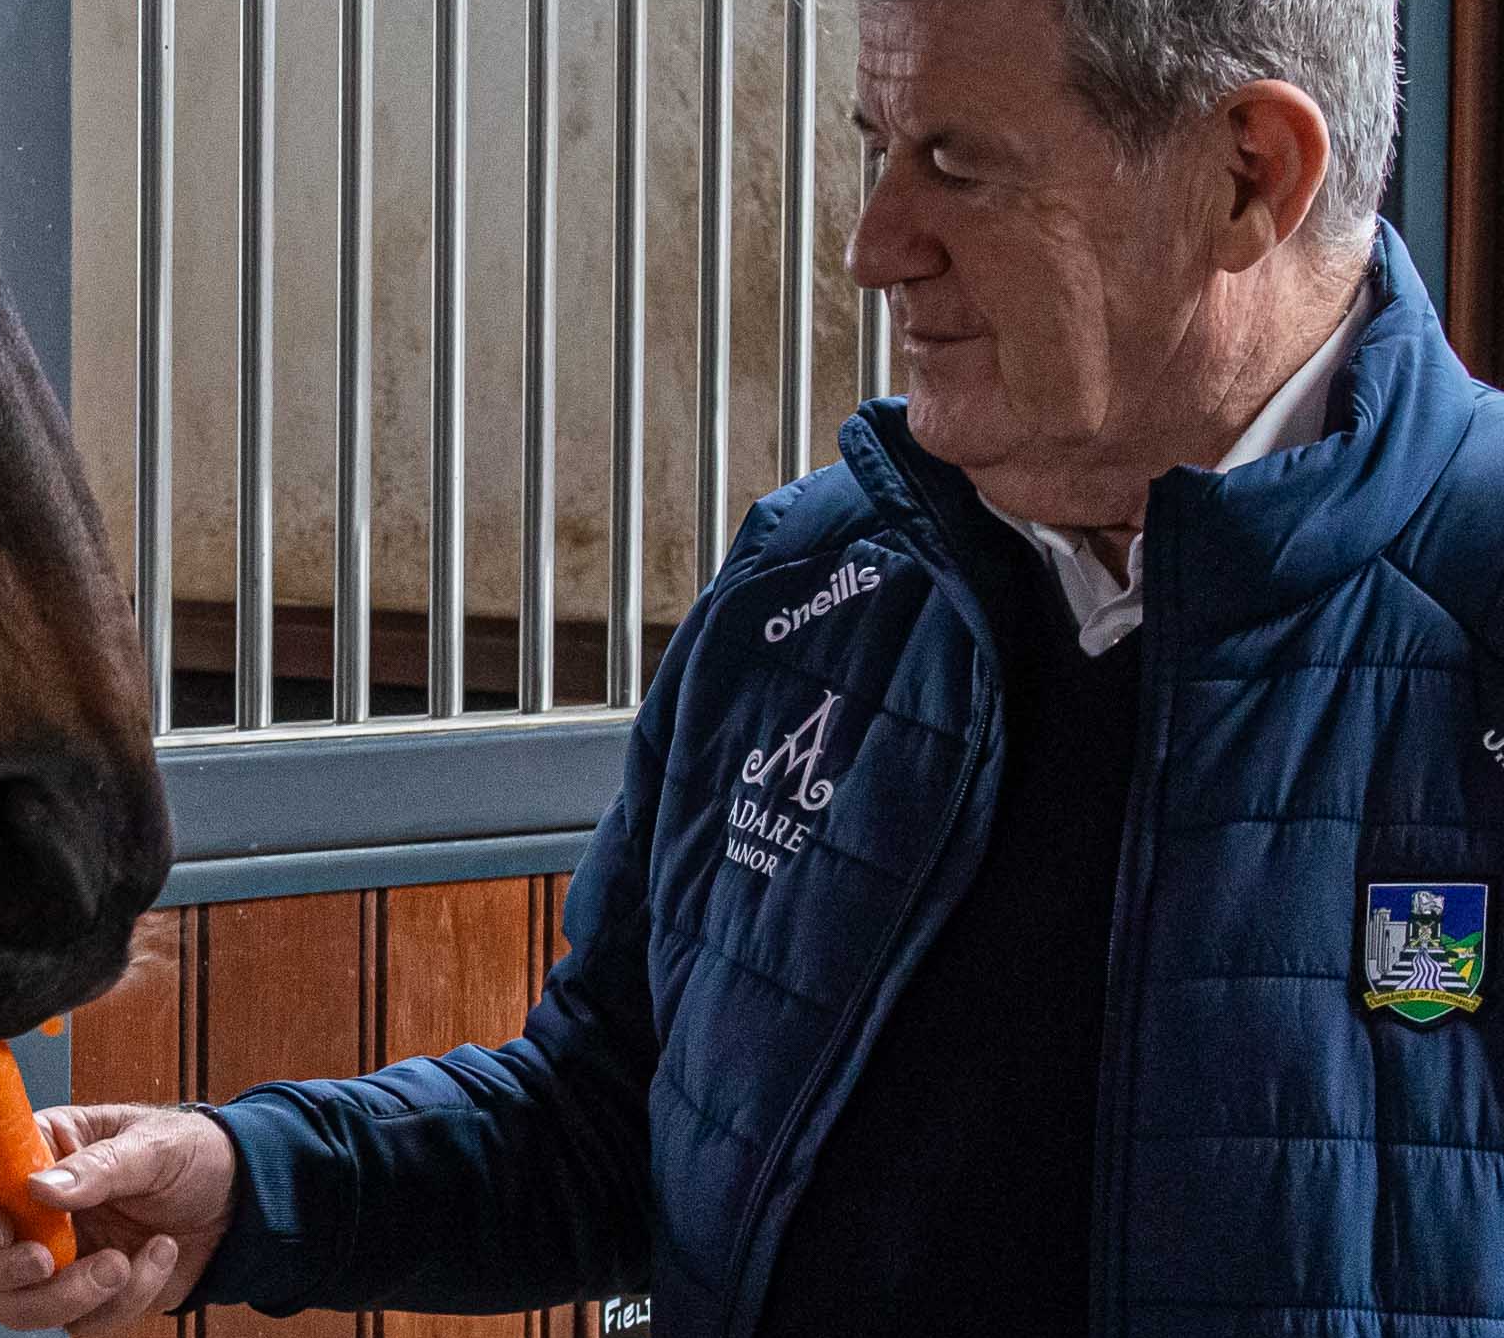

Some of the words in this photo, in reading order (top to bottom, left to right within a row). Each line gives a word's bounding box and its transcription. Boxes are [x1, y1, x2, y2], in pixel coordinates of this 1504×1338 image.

[765, 562, 881, 643] o'neills
[728, 796, 810, 852] ADARE
[725, 836, 778, 878] MANOR
